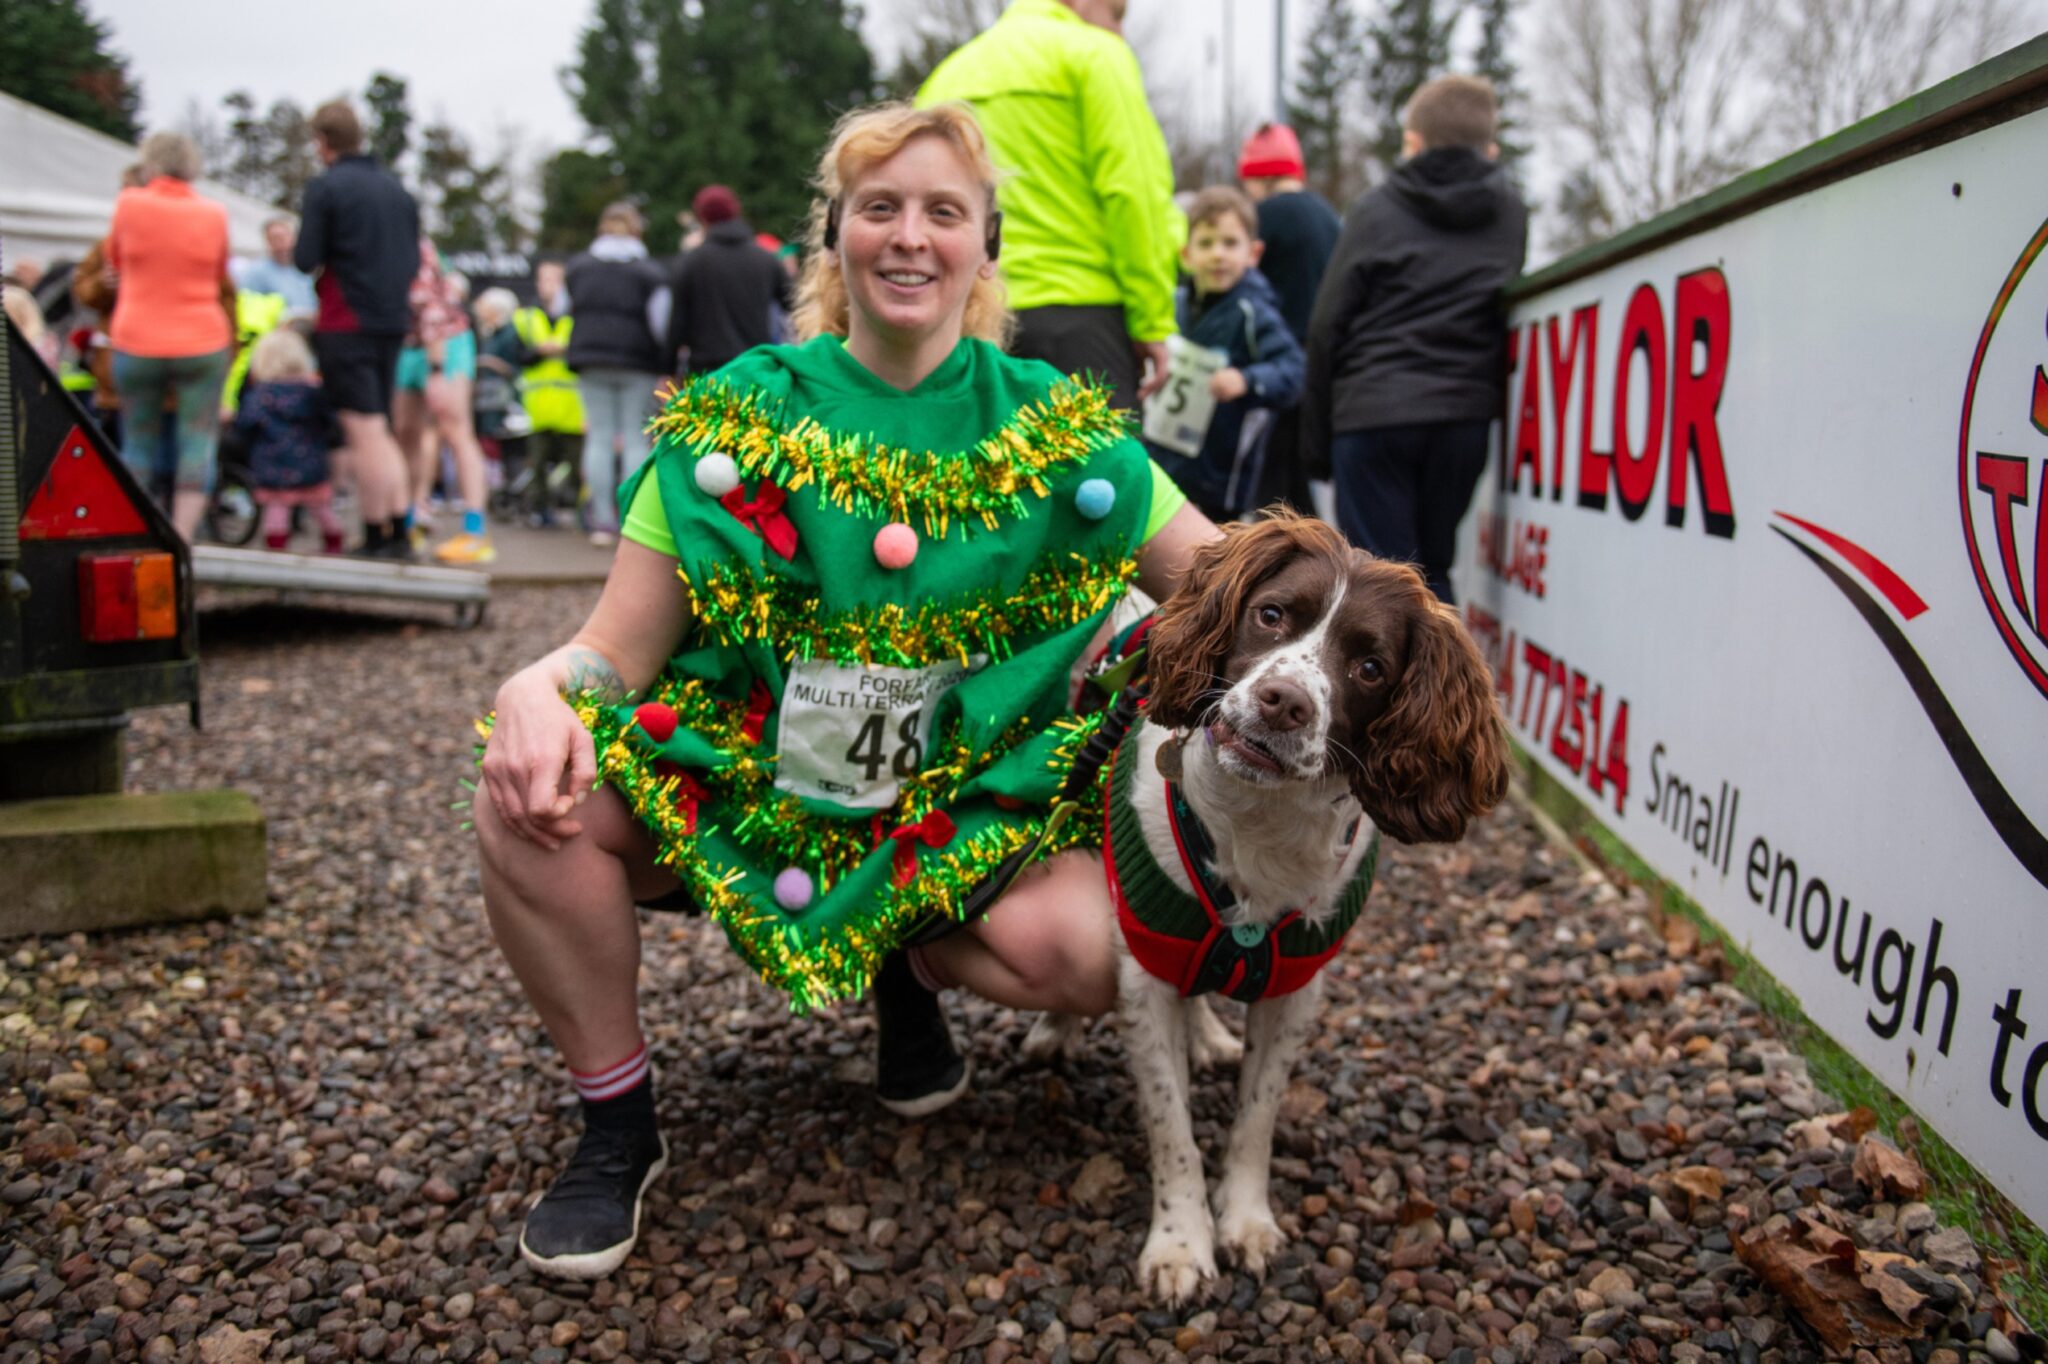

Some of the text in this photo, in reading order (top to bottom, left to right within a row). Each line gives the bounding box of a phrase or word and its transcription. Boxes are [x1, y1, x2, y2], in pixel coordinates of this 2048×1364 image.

[794, 683, 855, 709] MULTI
[1522, 639, 1629, 817] 772514
[1645, 741, 1739, 877] Small
[1746, 836, 1959, 1058] enough
